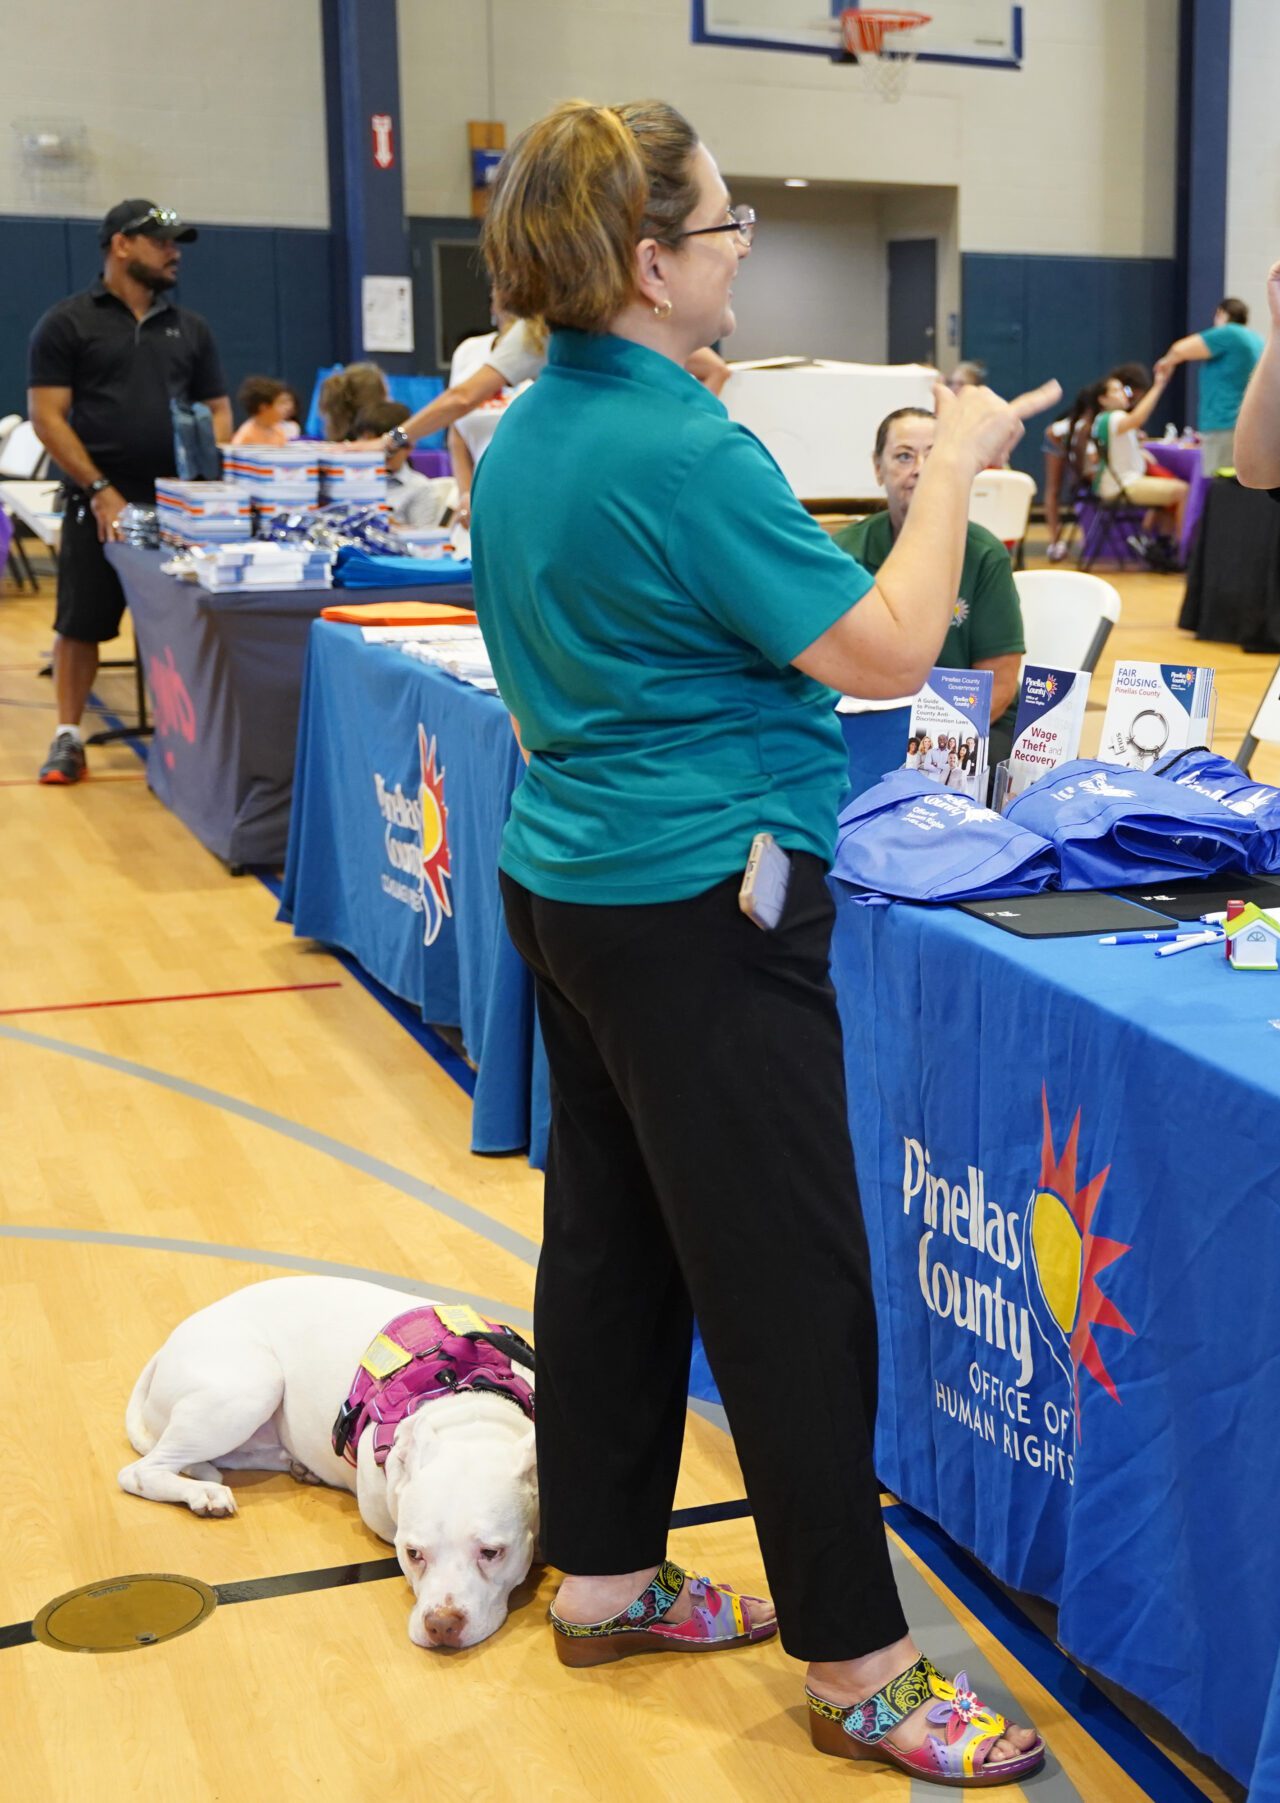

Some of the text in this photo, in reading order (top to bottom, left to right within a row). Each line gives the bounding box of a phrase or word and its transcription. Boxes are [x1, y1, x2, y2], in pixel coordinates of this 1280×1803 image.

[1118, 668, 1137, 677] FAIR
[941, 675, 980, 685] Pinellas County
[1025, 677, 1045, 687] Pinellas
[1116, 678, 1157, 689] HOUSING
[947, 683, 980, 691] Government
[1027, 685, 1045, 697] County
[1115, 687, 1160, 698] Pinellas County
[915, 715, 955, 724] Discrimination
[1031, 727, 1057, 742] Wage
[1022, 739, 1062, 755] Theft and
[1014, 750, 1057, 768] Recovery
[923, 795, 965, 817] County
[903, 1136, 1021, 1271] Pinellas
[918, 1231, 1033, 1387] County
[969, 1361, 1069, 1441] OFFICE OF
[935, 1379, 1074, 1487] HUMAN RIGHTS
